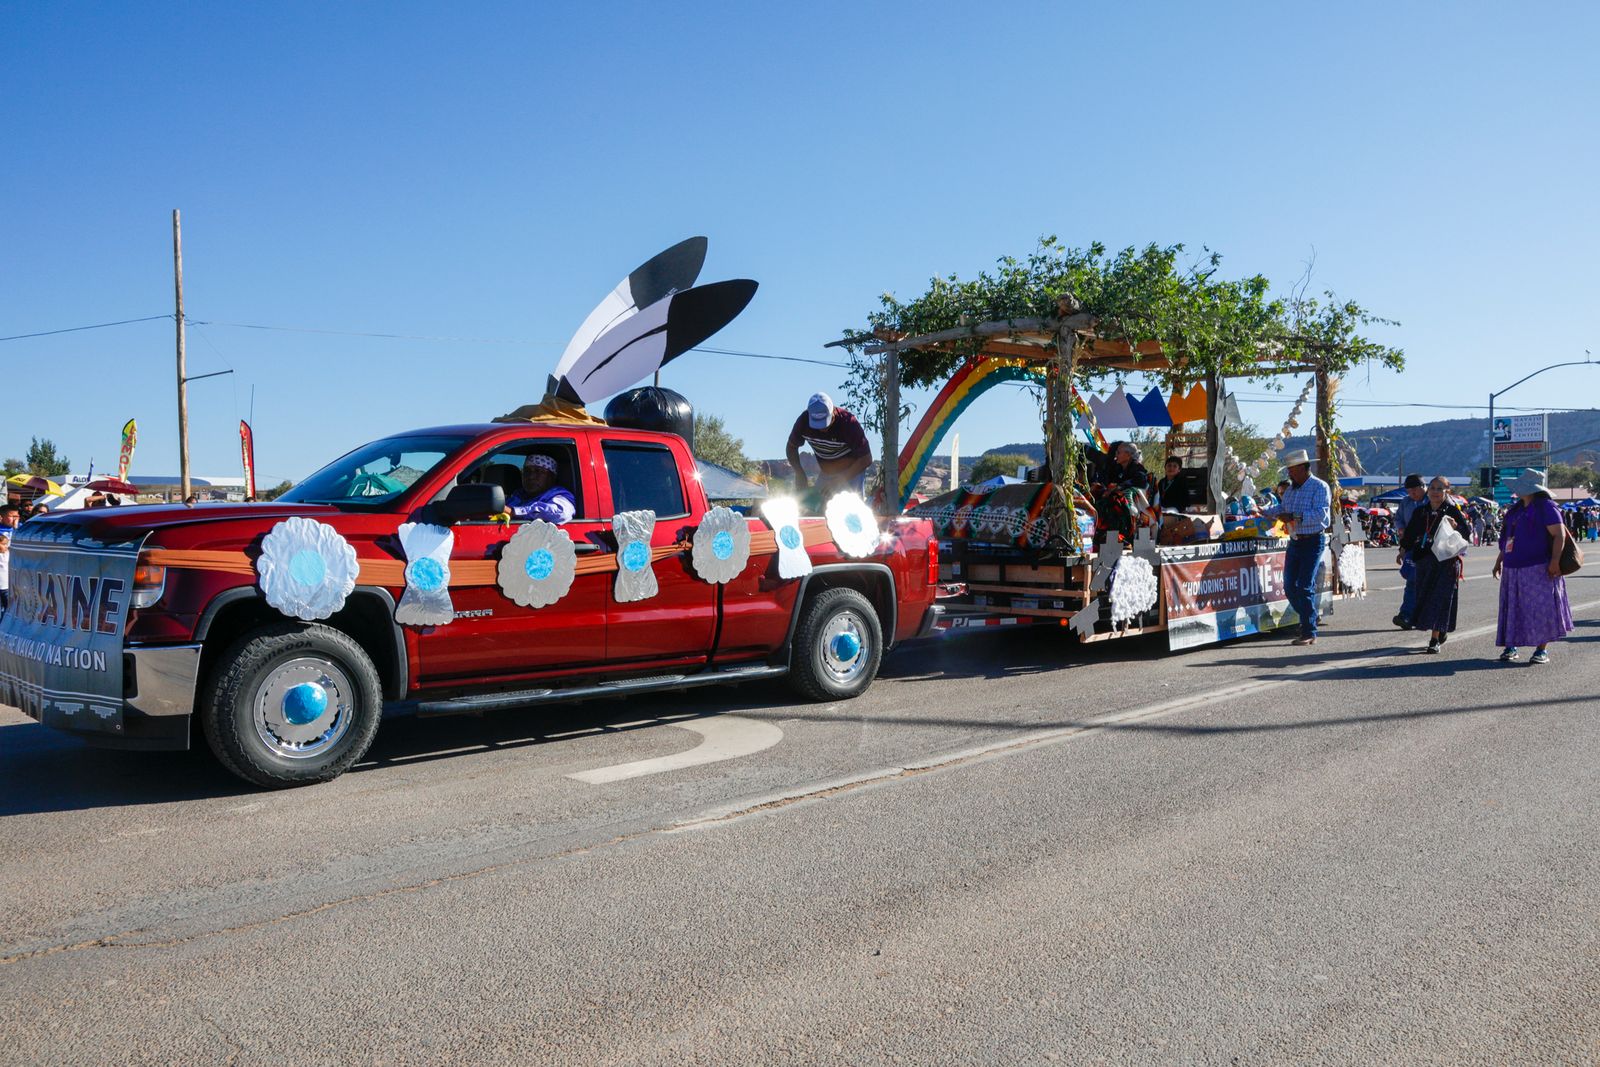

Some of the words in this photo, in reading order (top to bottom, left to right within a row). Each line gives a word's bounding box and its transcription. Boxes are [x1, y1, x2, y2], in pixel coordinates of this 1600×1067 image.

[1198, 543, 1224, 556] JUDICIAL
[1225, 541, 1248, 554] BRANCH
[1250, 540, 1256, 550] OF
[1257, 539, 1267, 550] THE
[1225, 576, 1238, 590] THE
[1240, 557, 1273, 596] DINÉ
[1273, 571, 1284, 584] WA
[951, 617, 969, 628] PJ
[15, 637, 46, 662] NAVAJO
[45, 645, 106, 672] NATION
